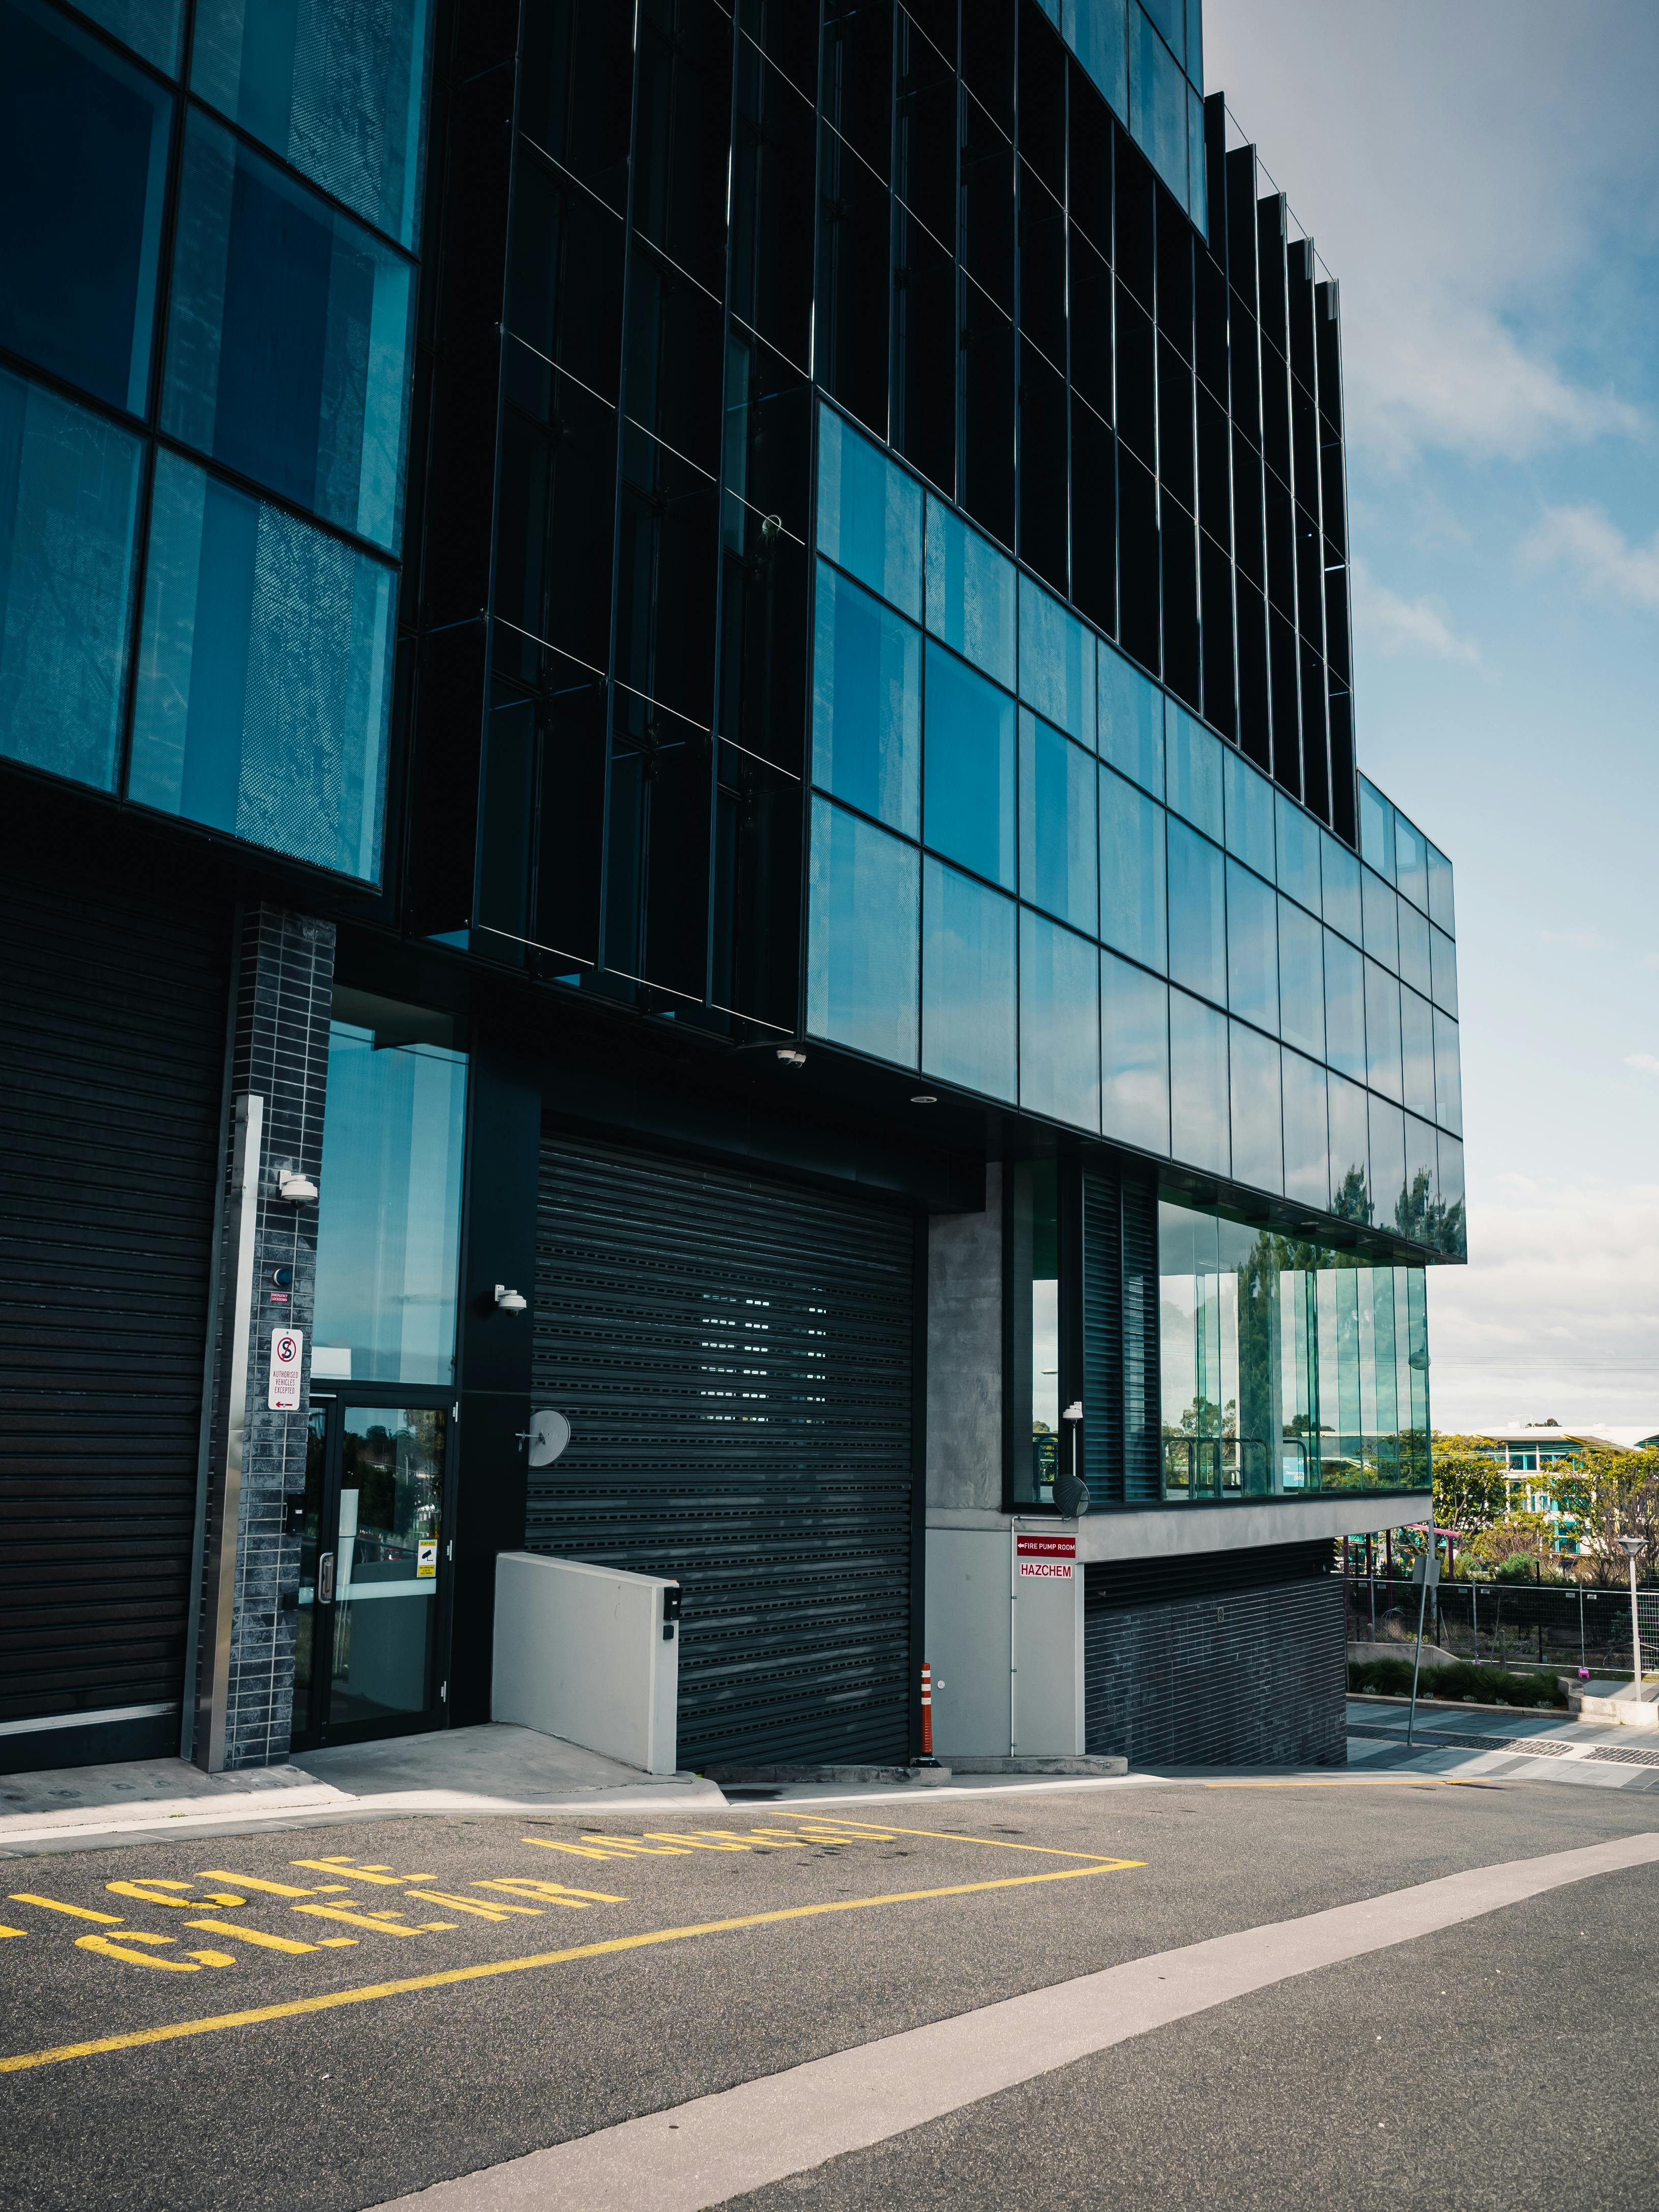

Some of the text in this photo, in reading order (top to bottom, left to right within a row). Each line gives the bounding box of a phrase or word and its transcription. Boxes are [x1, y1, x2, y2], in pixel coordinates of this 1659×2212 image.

[273, 1370, 298, 1378] AUTHORISED
[274, 1386, 295, 1394] EXCEPTED
[1021, 1564, 1071, 1577] HAZCHEM
[0, 1826, 898, 1937] ICLE ACCESS
[75, 1878, 630, 1972] CLEAR
